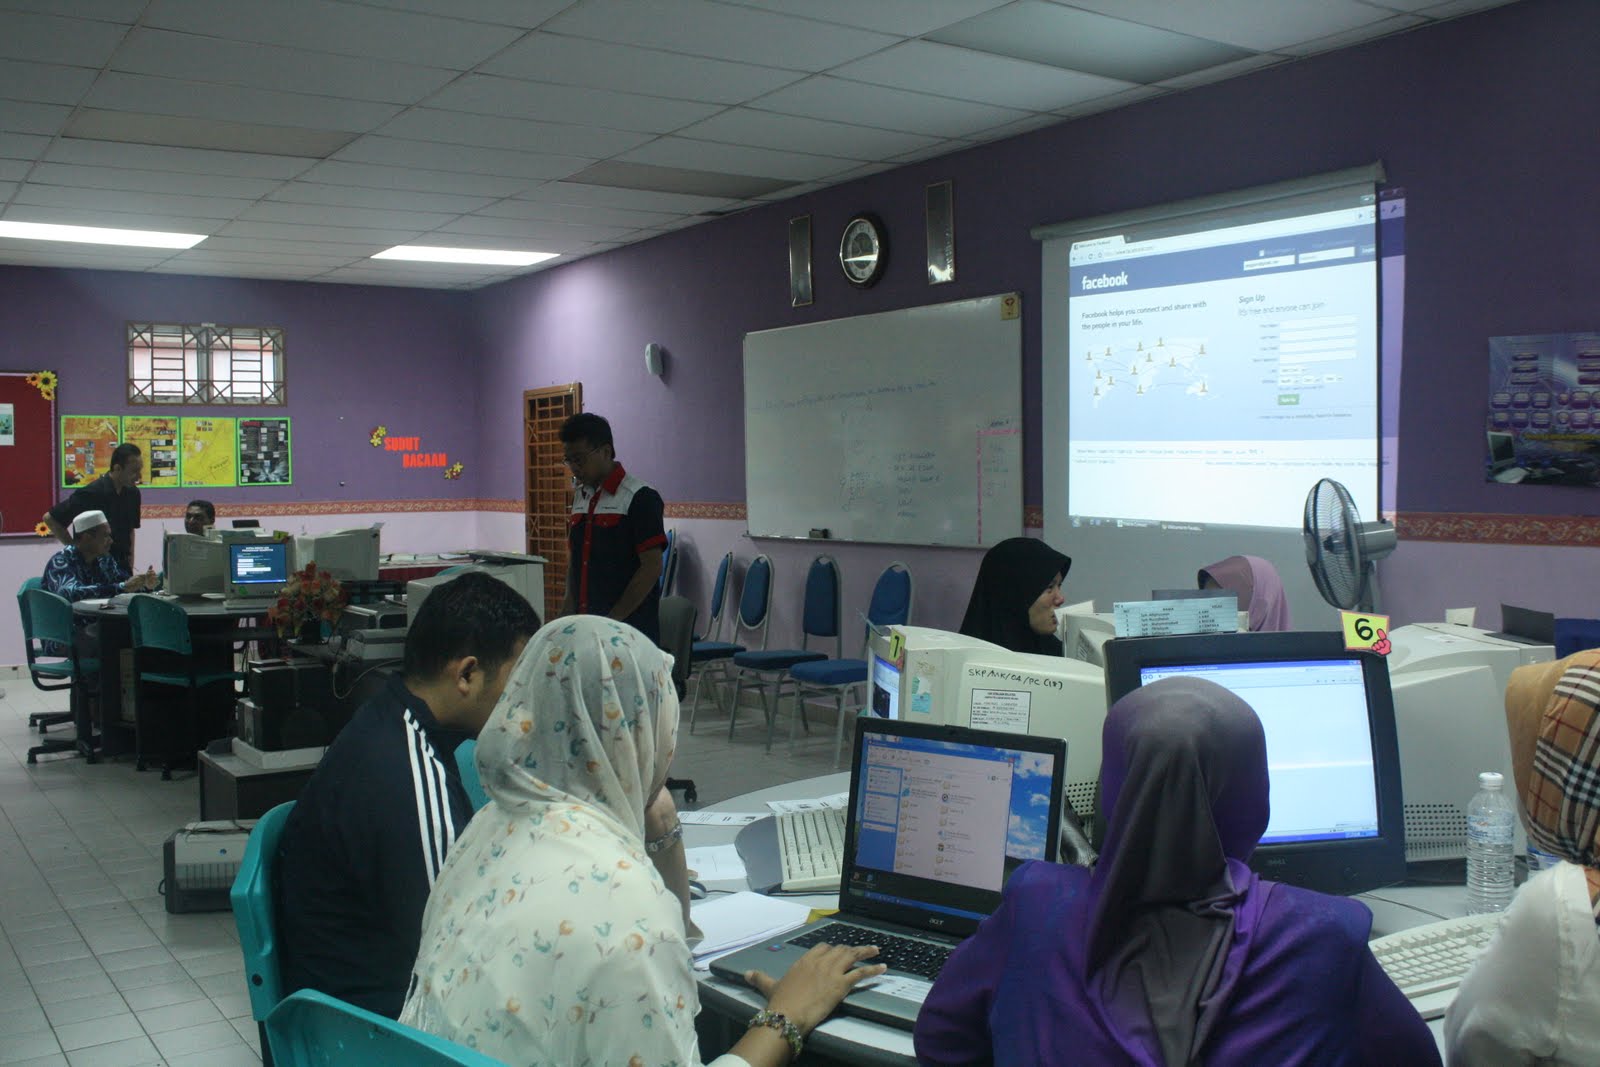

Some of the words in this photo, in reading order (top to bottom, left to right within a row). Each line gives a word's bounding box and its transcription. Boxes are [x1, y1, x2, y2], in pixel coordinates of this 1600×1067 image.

[1081, 271, 1128, 290] facebook
[1081, 311, 1108, 320] Facebook
[1109, 309, 1124, 318] helps
[1125, 308, 1136, 316] you
[1136, 306, 1160, 314] connect
[1161, 303, 1173, 311] and
[1174, 302, 1191, 310] share
[1192, 300, 1207, 308] with
[1092, 322, 1111, 331] people
[1118, 321, 1131, 329] your
[384, 437, 420, 451] SUDUT
[403, 453, 447, 468] BACAAN
[1354, 617, 1374, 641] 6
